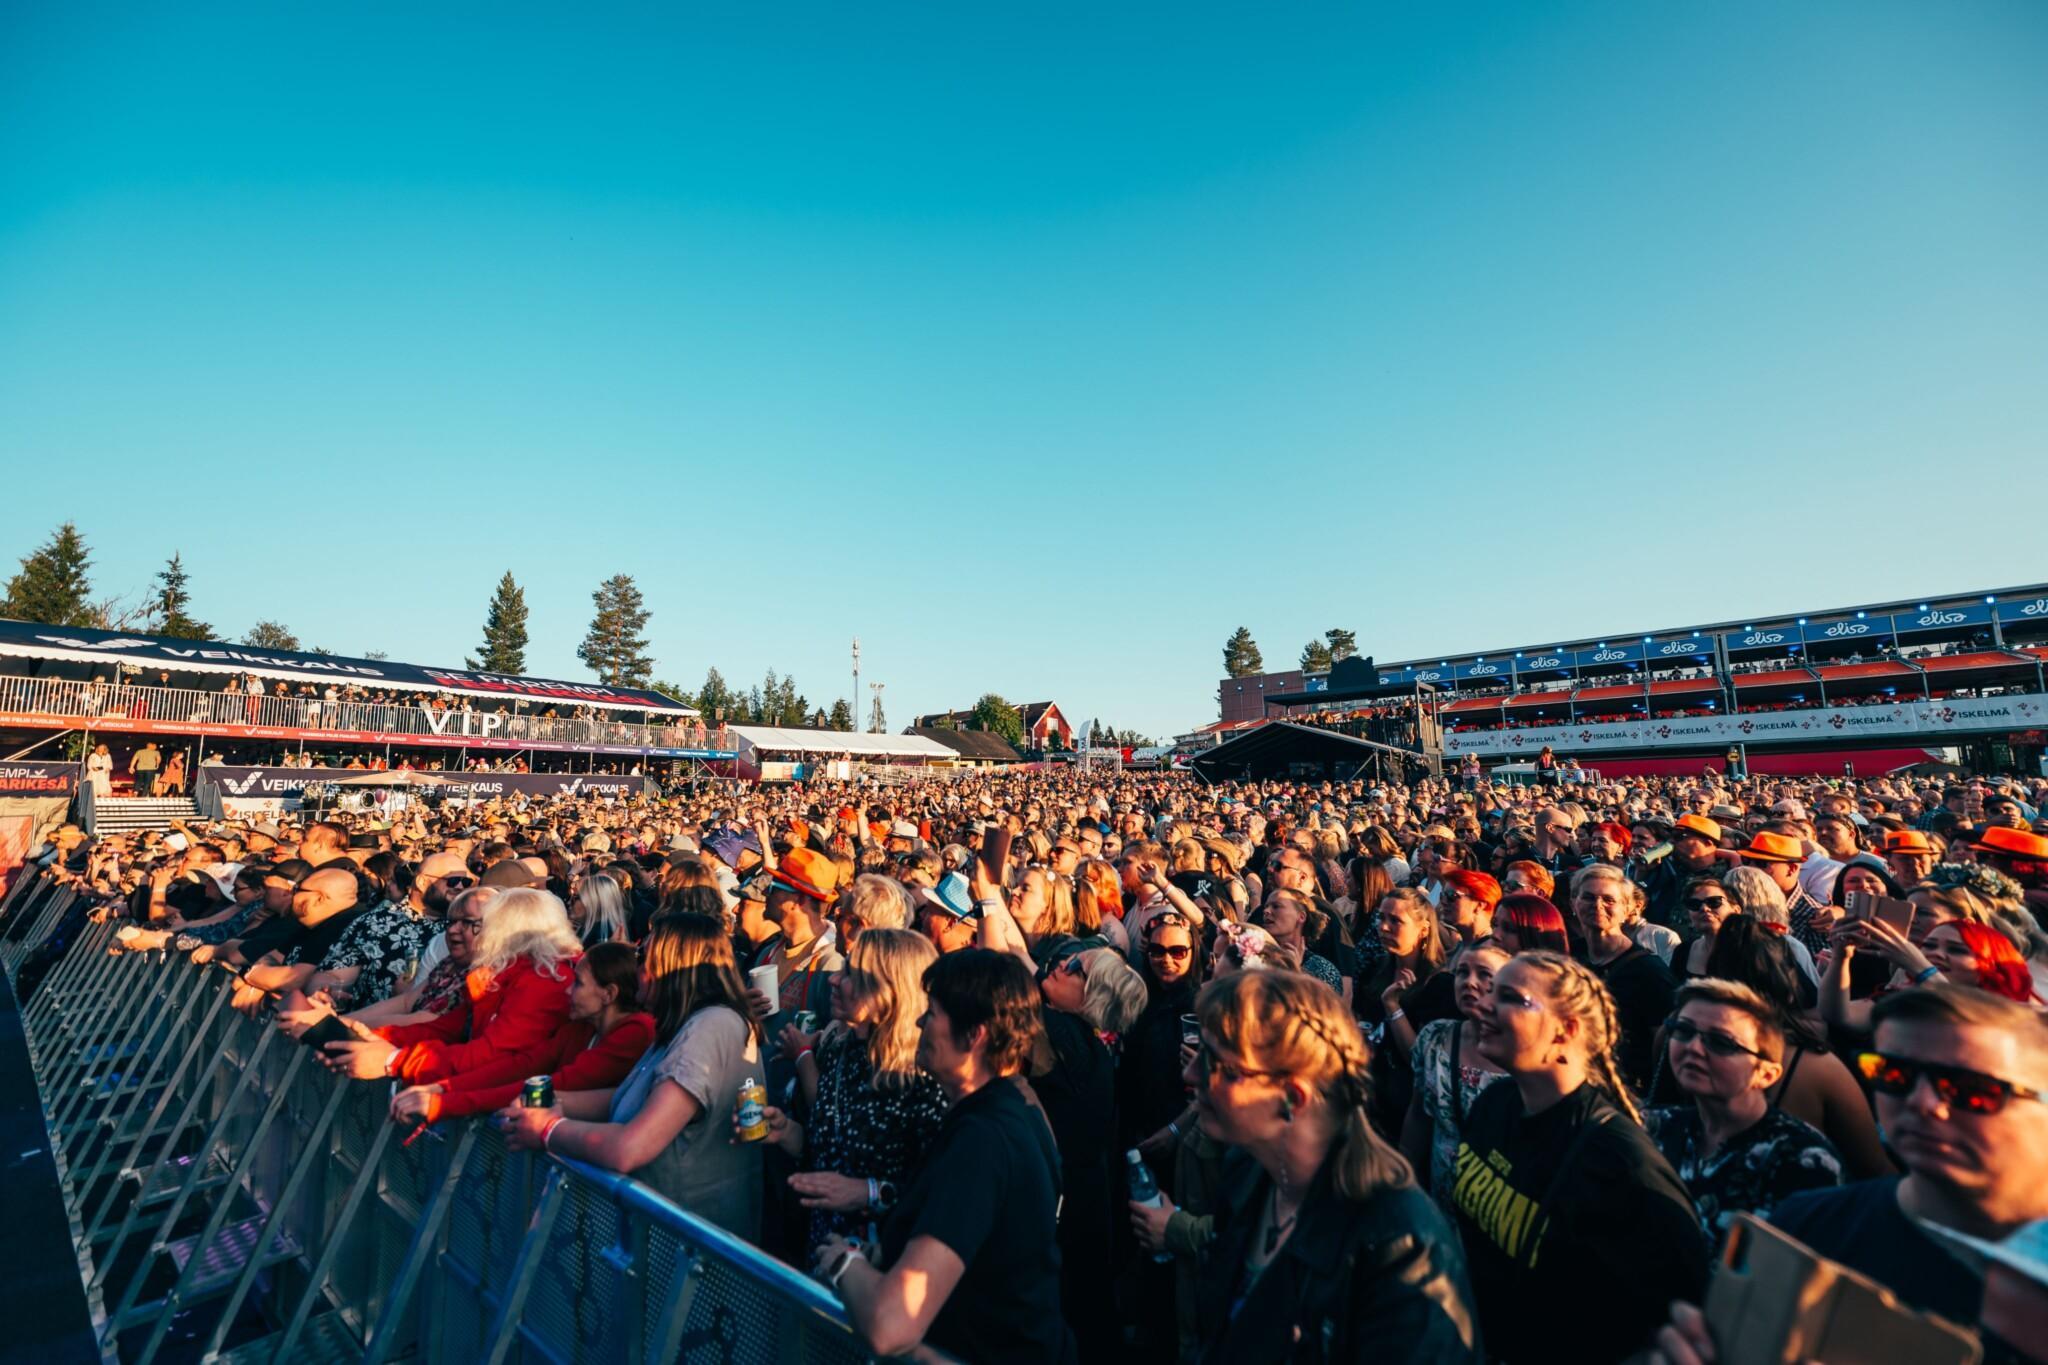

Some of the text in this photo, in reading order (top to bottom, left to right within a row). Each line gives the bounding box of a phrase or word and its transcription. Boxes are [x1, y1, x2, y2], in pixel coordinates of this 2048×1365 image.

[1917, 611, 1967, 626] elisa
[1824, 622, 1870, 637] elisa
[1743, 631, 1784, 646] elisa
[1660, 640, 1697, 654] elisa
[160, 646, 385, 676] VEIKKAUS
[1593, 650, 1627, 662] elisa
[1529, 657, 1560, 669] elisa
[1469, 664, 1498, 675] elisa
[1414, 671, 1440, 681] elisa
[1959, 707, 2011, 718] ISKELMÄ
[422, 709, 502, 738] VIP
[1755, 720, 1797, 730] ISKELMÄ
[1847, 714, 1894, 726] ISKELMÄ
[1593, 731, 1628, 740] ISKELMÄ
[1673, 726, 1711, 736] ISKELMÄ
[1461, 740, 1490, 748] ISKELMÄ
[1525, 735, 1556, 744] ISKELMÄ
